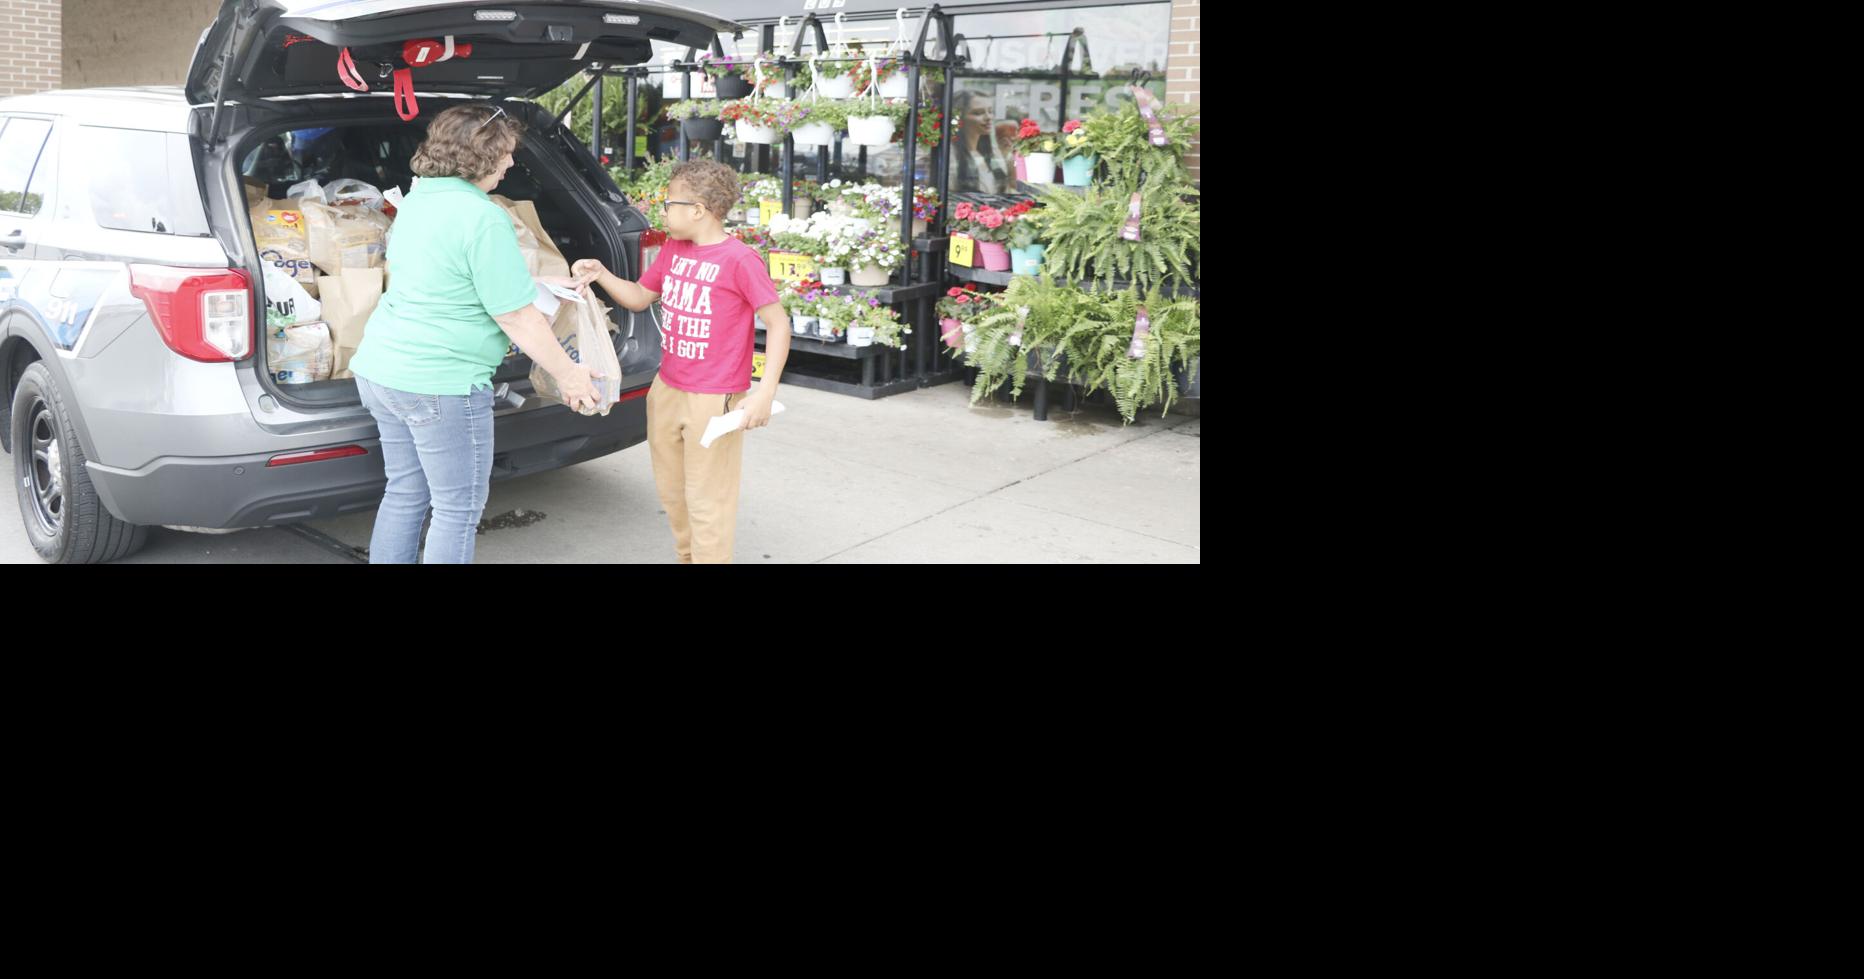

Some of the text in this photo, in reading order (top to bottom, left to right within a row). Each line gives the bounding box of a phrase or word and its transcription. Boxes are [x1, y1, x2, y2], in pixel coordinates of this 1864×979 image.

[695, 261, 720, 283] NO
[45, 300, 78, 325] 911
[677, 315, 711, 338] THE
[677, 340, 709, 360] GOT
